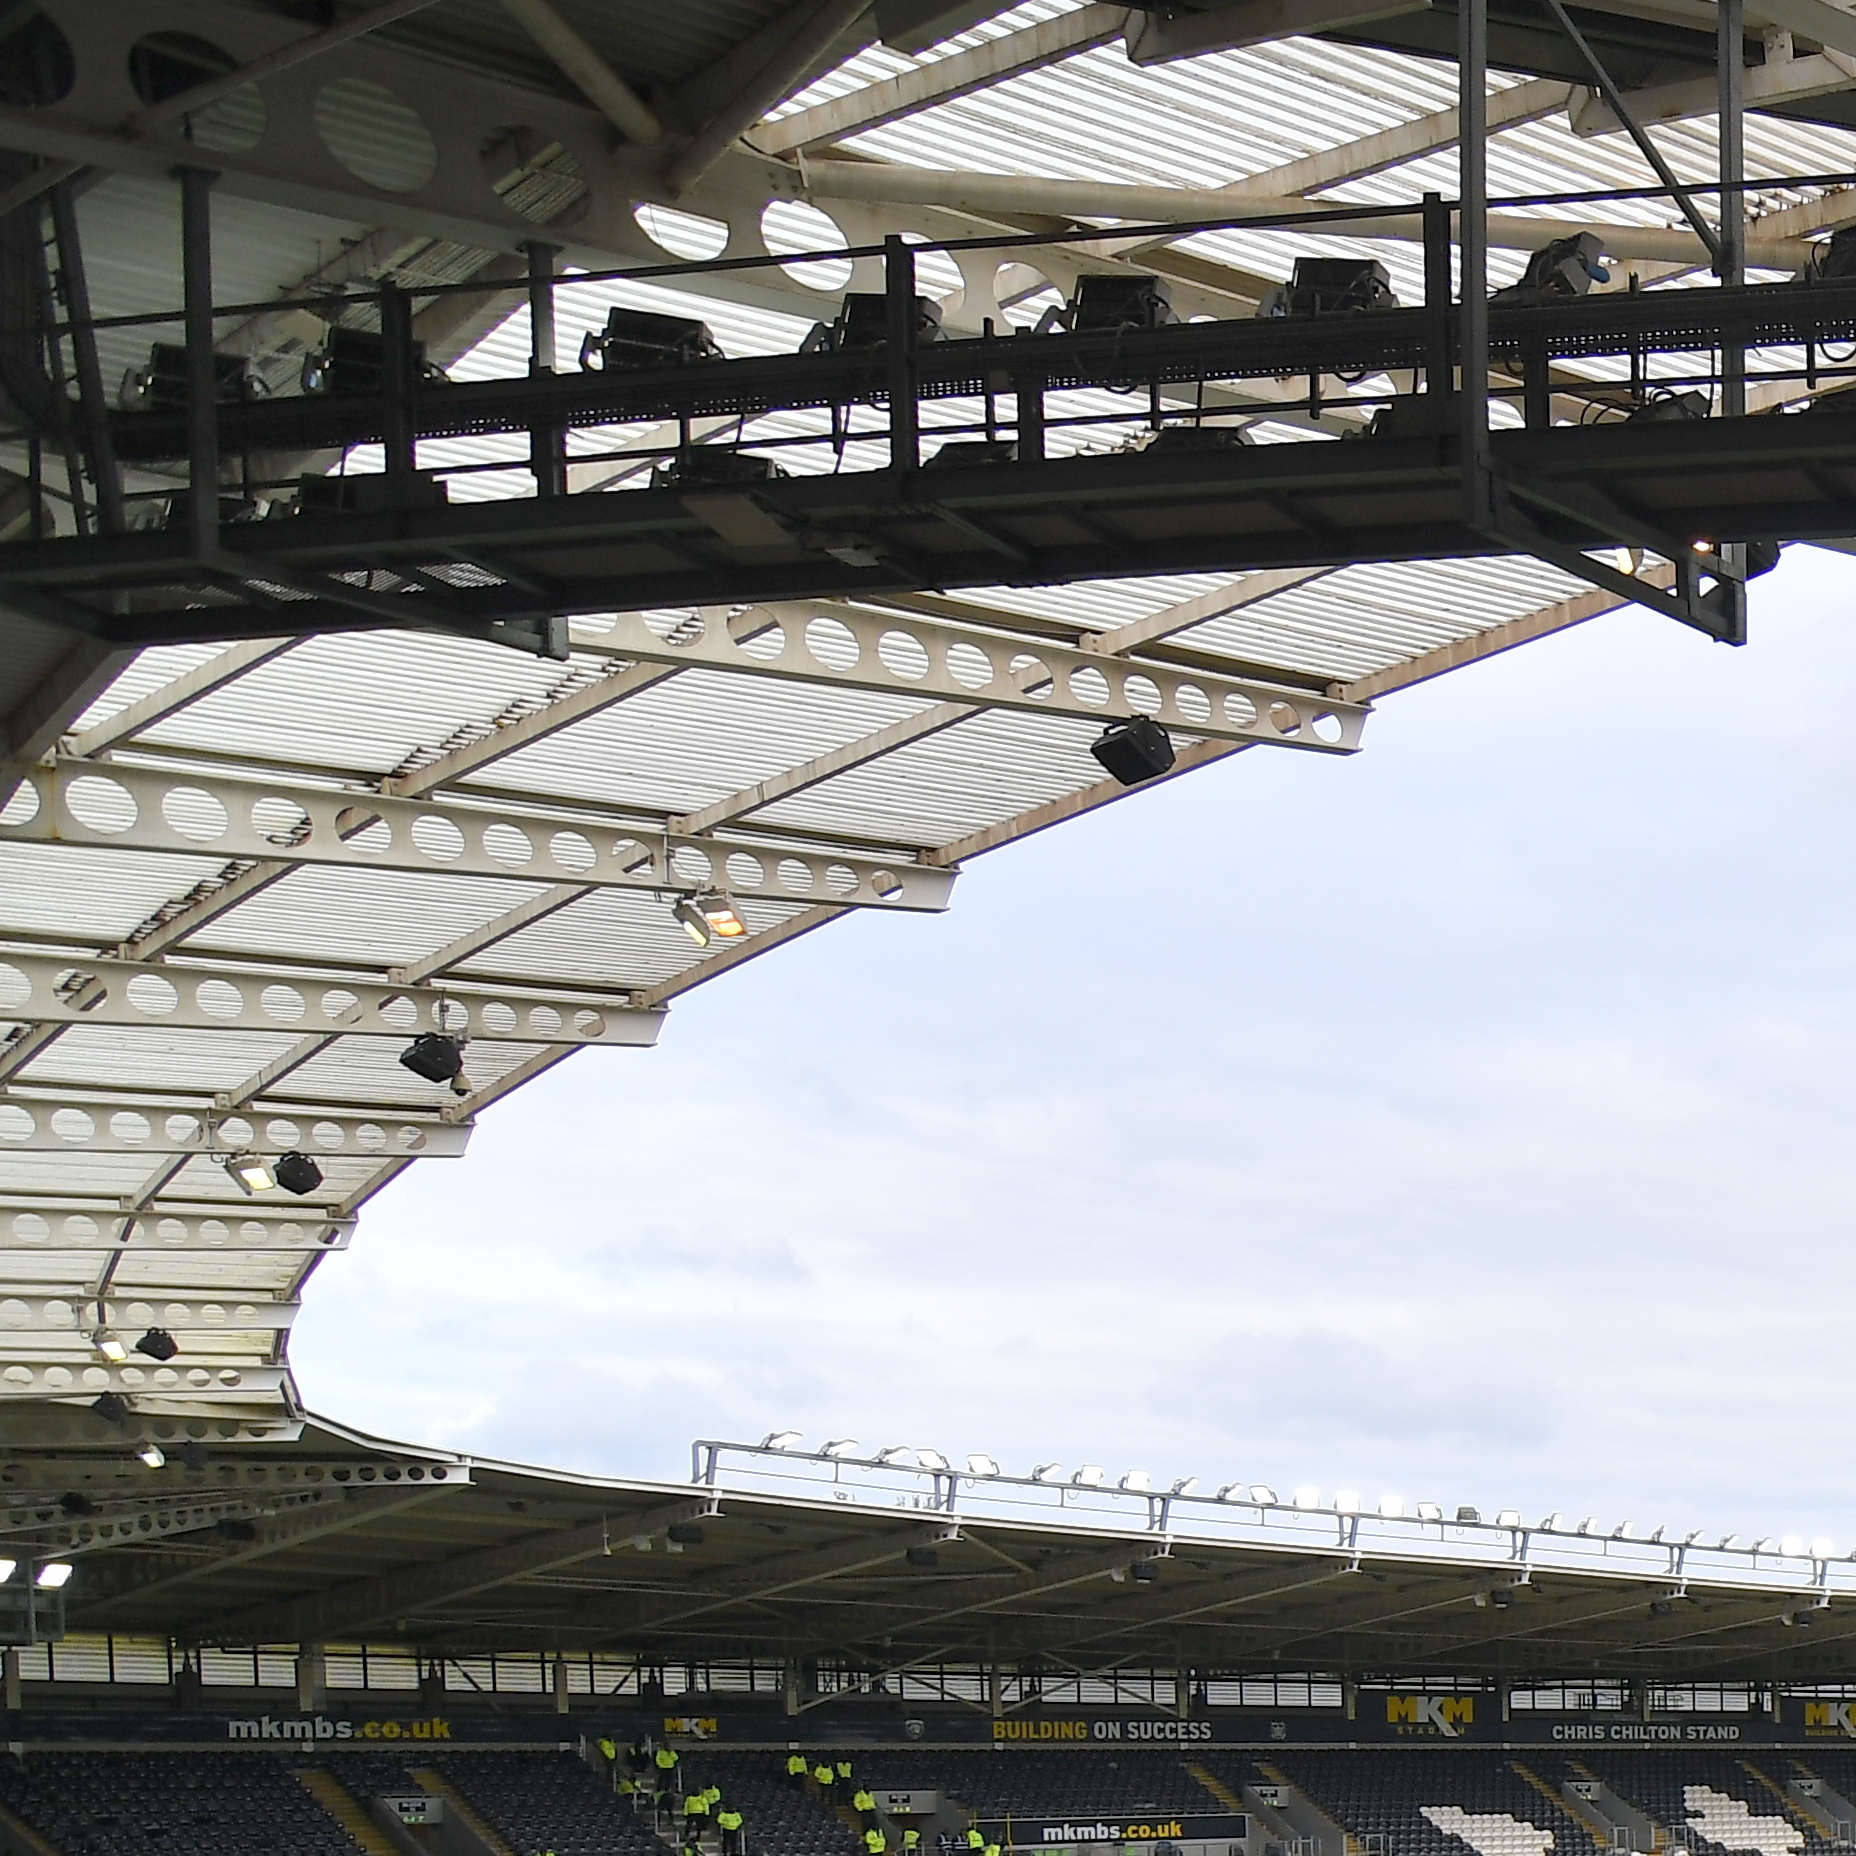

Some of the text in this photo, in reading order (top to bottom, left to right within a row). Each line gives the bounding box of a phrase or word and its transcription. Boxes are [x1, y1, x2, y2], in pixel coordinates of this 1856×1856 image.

[228, 1715, 450, 1739] mkmbs.co.uk
[1386, 1696, 1473, 1737] MKM
[664, 1717, 717, 1739] MKM
[992, 1721, 1212, 1740] BUILDING ON SUCCESS
[1552, 1725, 1740, 1740] CHRIS CHILTON STAND
[1042, 1820, 1183, 1842] mkmbs.co.uk
